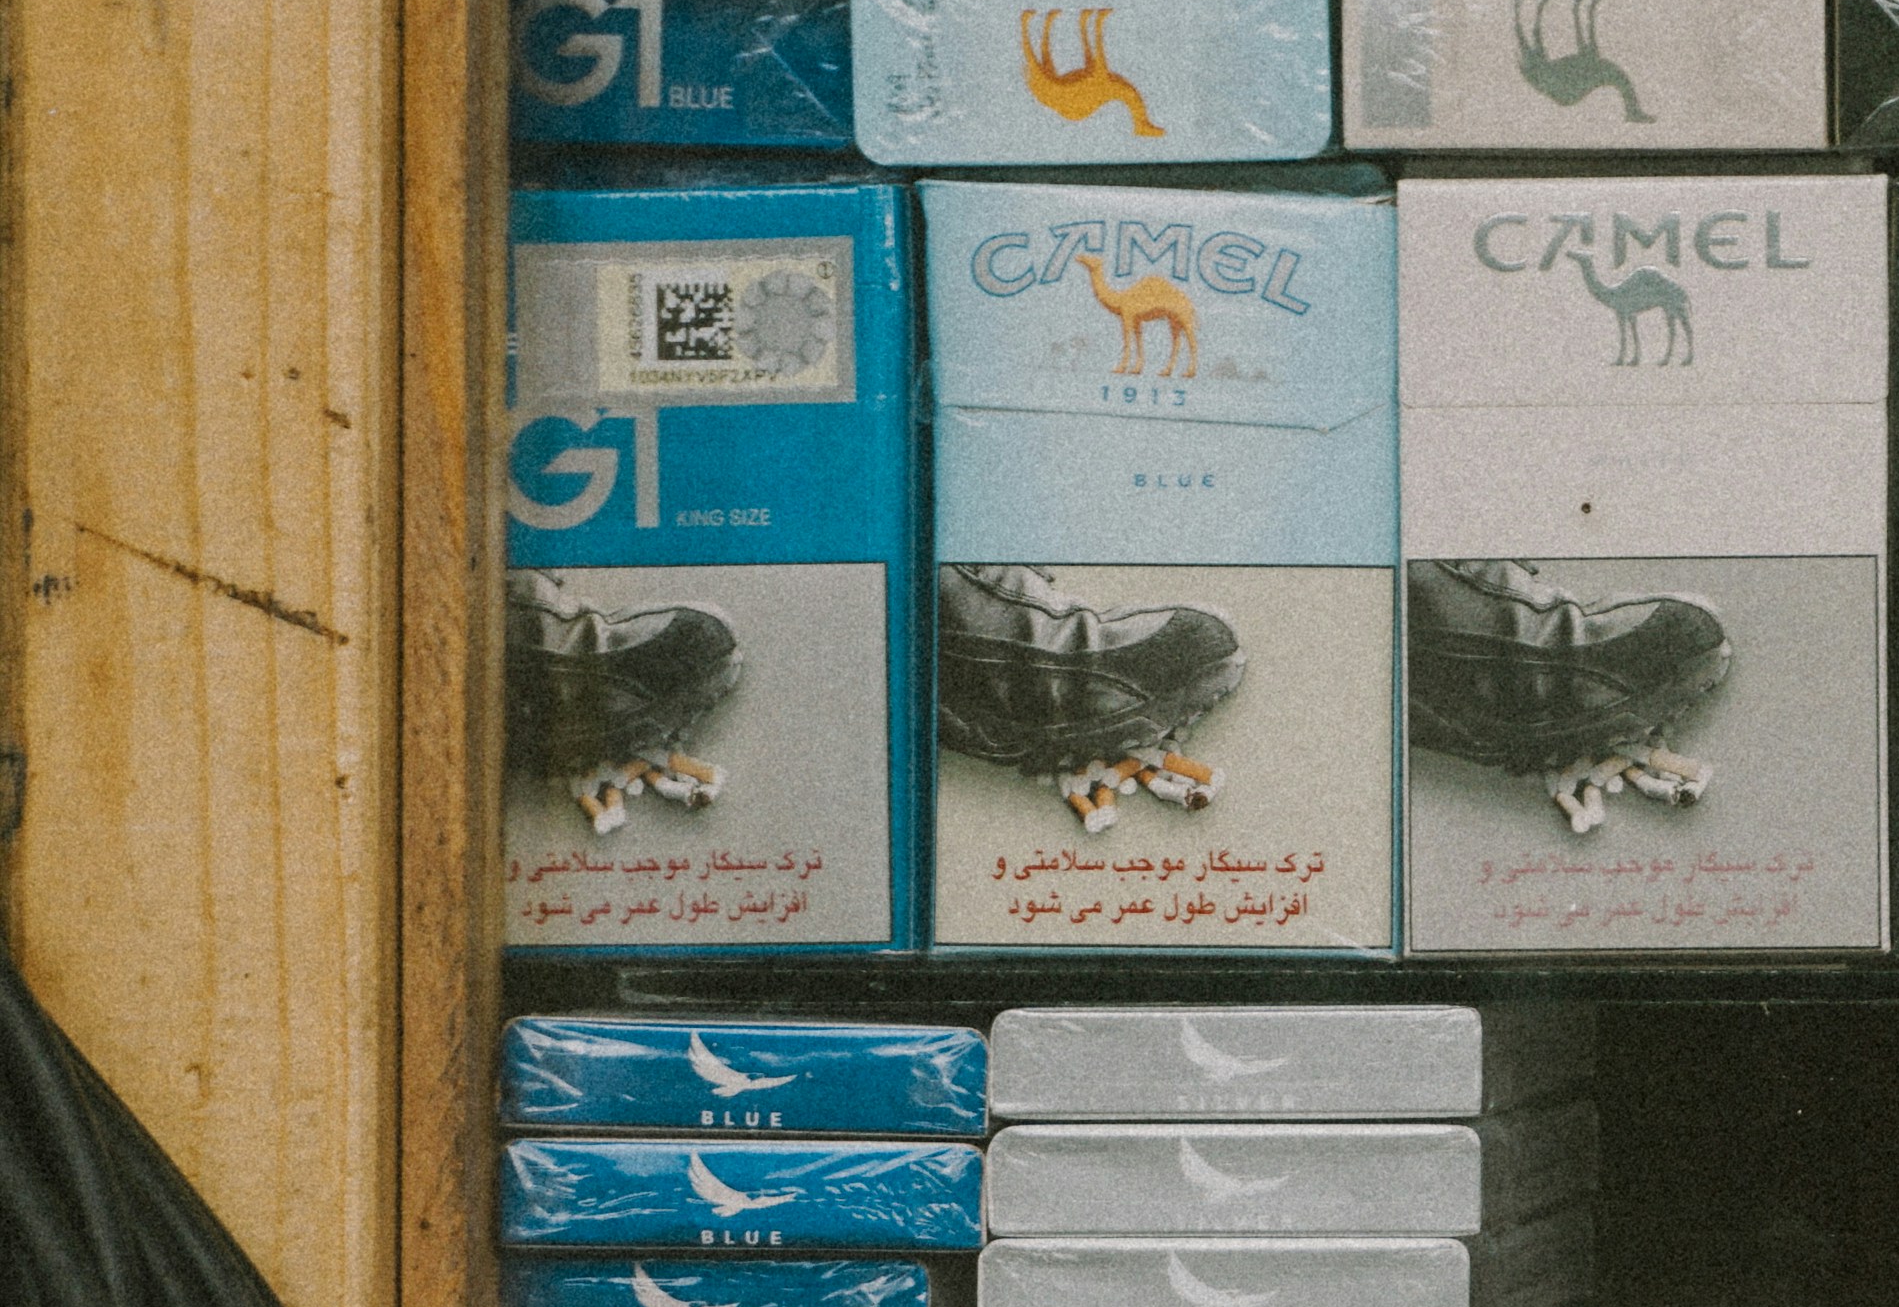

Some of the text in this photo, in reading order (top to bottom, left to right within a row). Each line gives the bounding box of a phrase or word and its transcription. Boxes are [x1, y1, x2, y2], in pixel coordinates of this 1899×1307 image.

[669, 86, 733, 111] BLUE
[1473, 209, 1810, 273] CAMEL
[970, 221, 1311, 316] CAMEL
[1100, 385, 1189, 406] 1913
[509, 407, 660, 530] G1
[1133, 473, 1215, 488] BLUE
[676, 508, 771, 527] KING SIZE
[992, 850, 1324, 883] ترک سیگار موجب سلامتی و
[1009, 892, 1307, 925] افزایش طول عمر می شود
[700, 1110, 783, 1128] BLUE
[700, 1229, 783, 1245] BLUE
